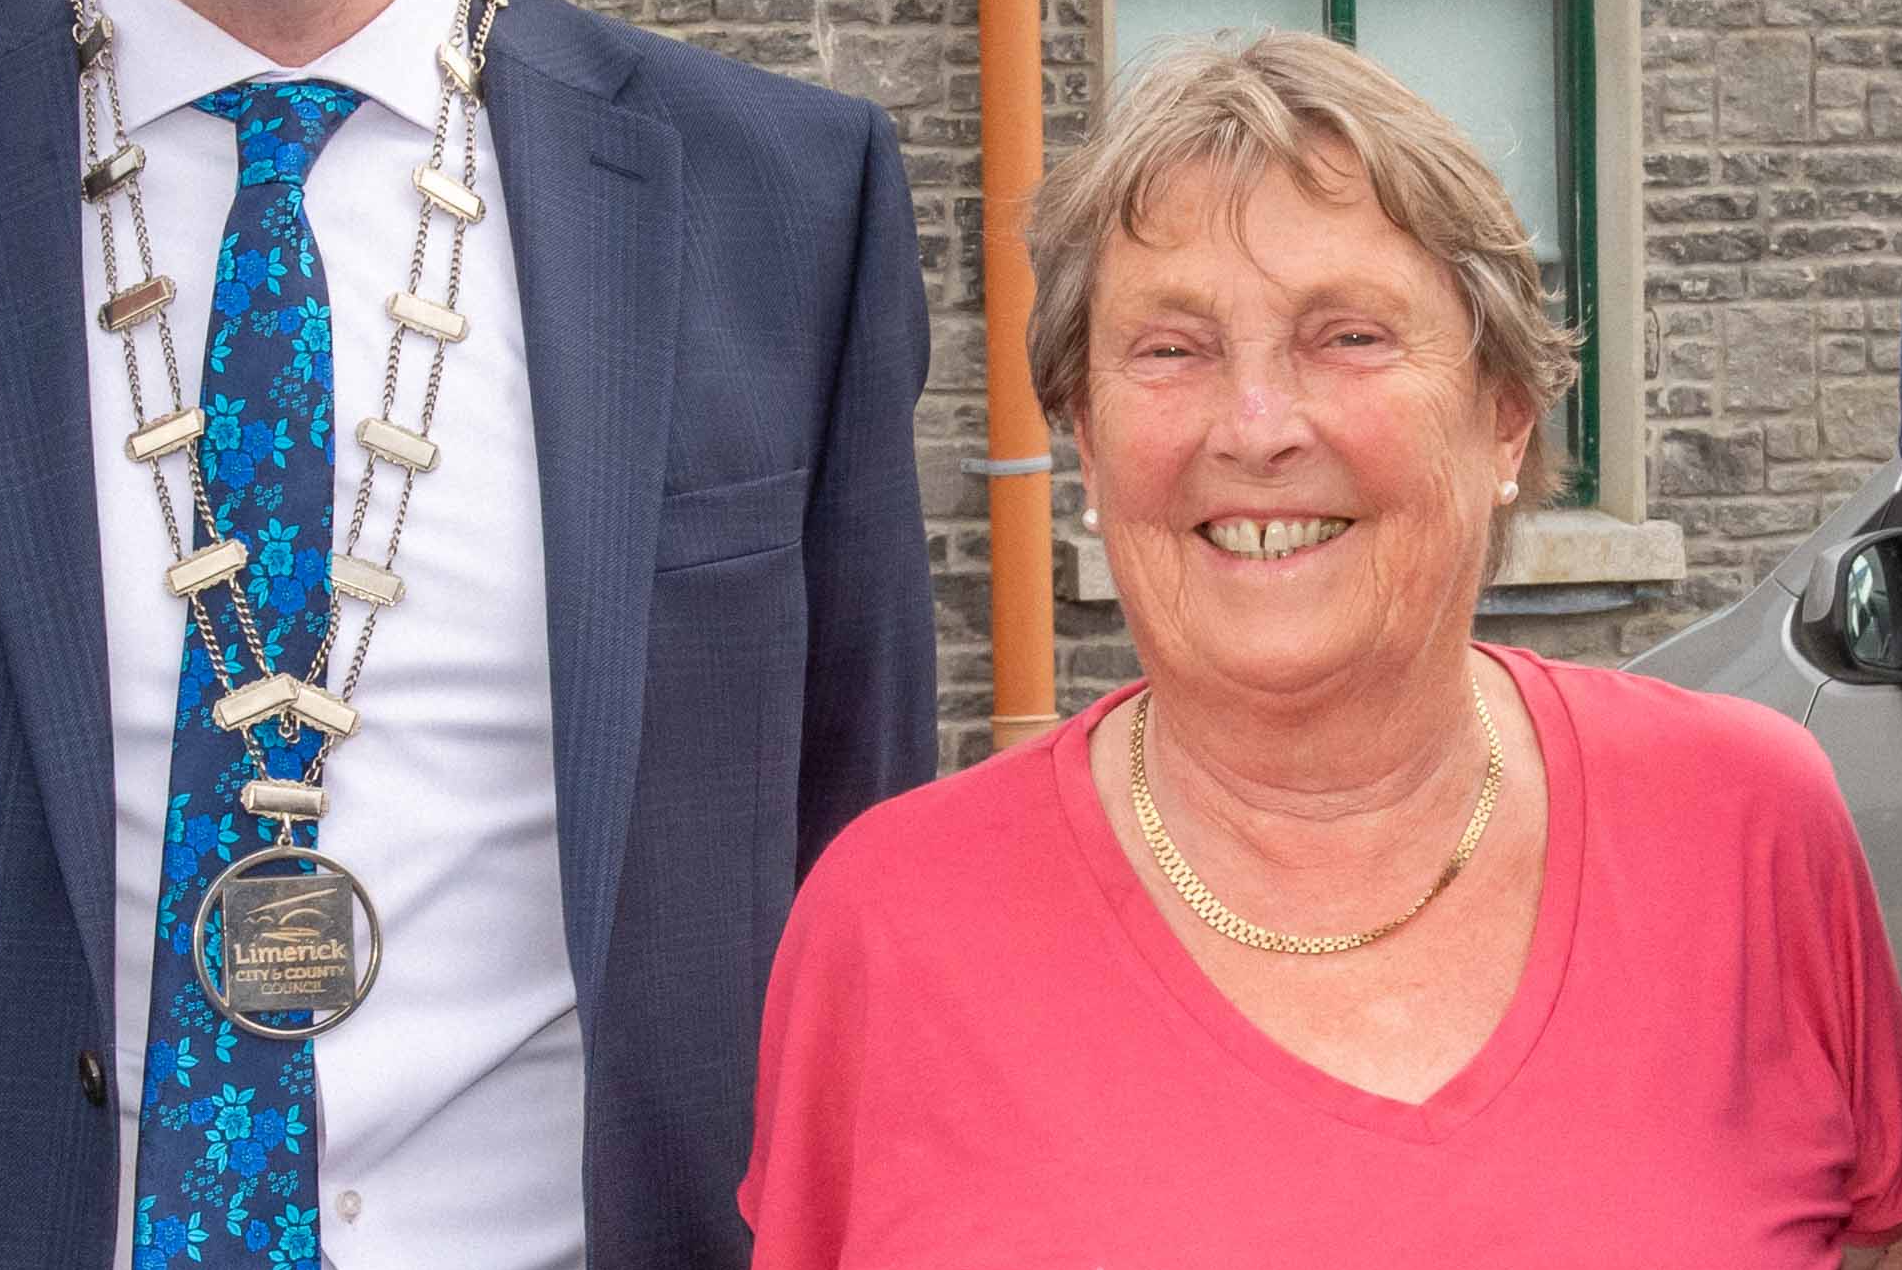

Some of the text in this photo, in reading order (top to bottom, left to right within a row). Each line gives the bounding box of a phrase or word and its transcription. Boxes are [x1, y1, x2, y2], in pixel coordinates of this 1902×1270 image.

[234, 938, 346, 964] Limerick
[236, 969, 270, 981] CITY
[284, 965, 346, 979] COUNTY
[261, 980, 326, 994] COUNCIL
